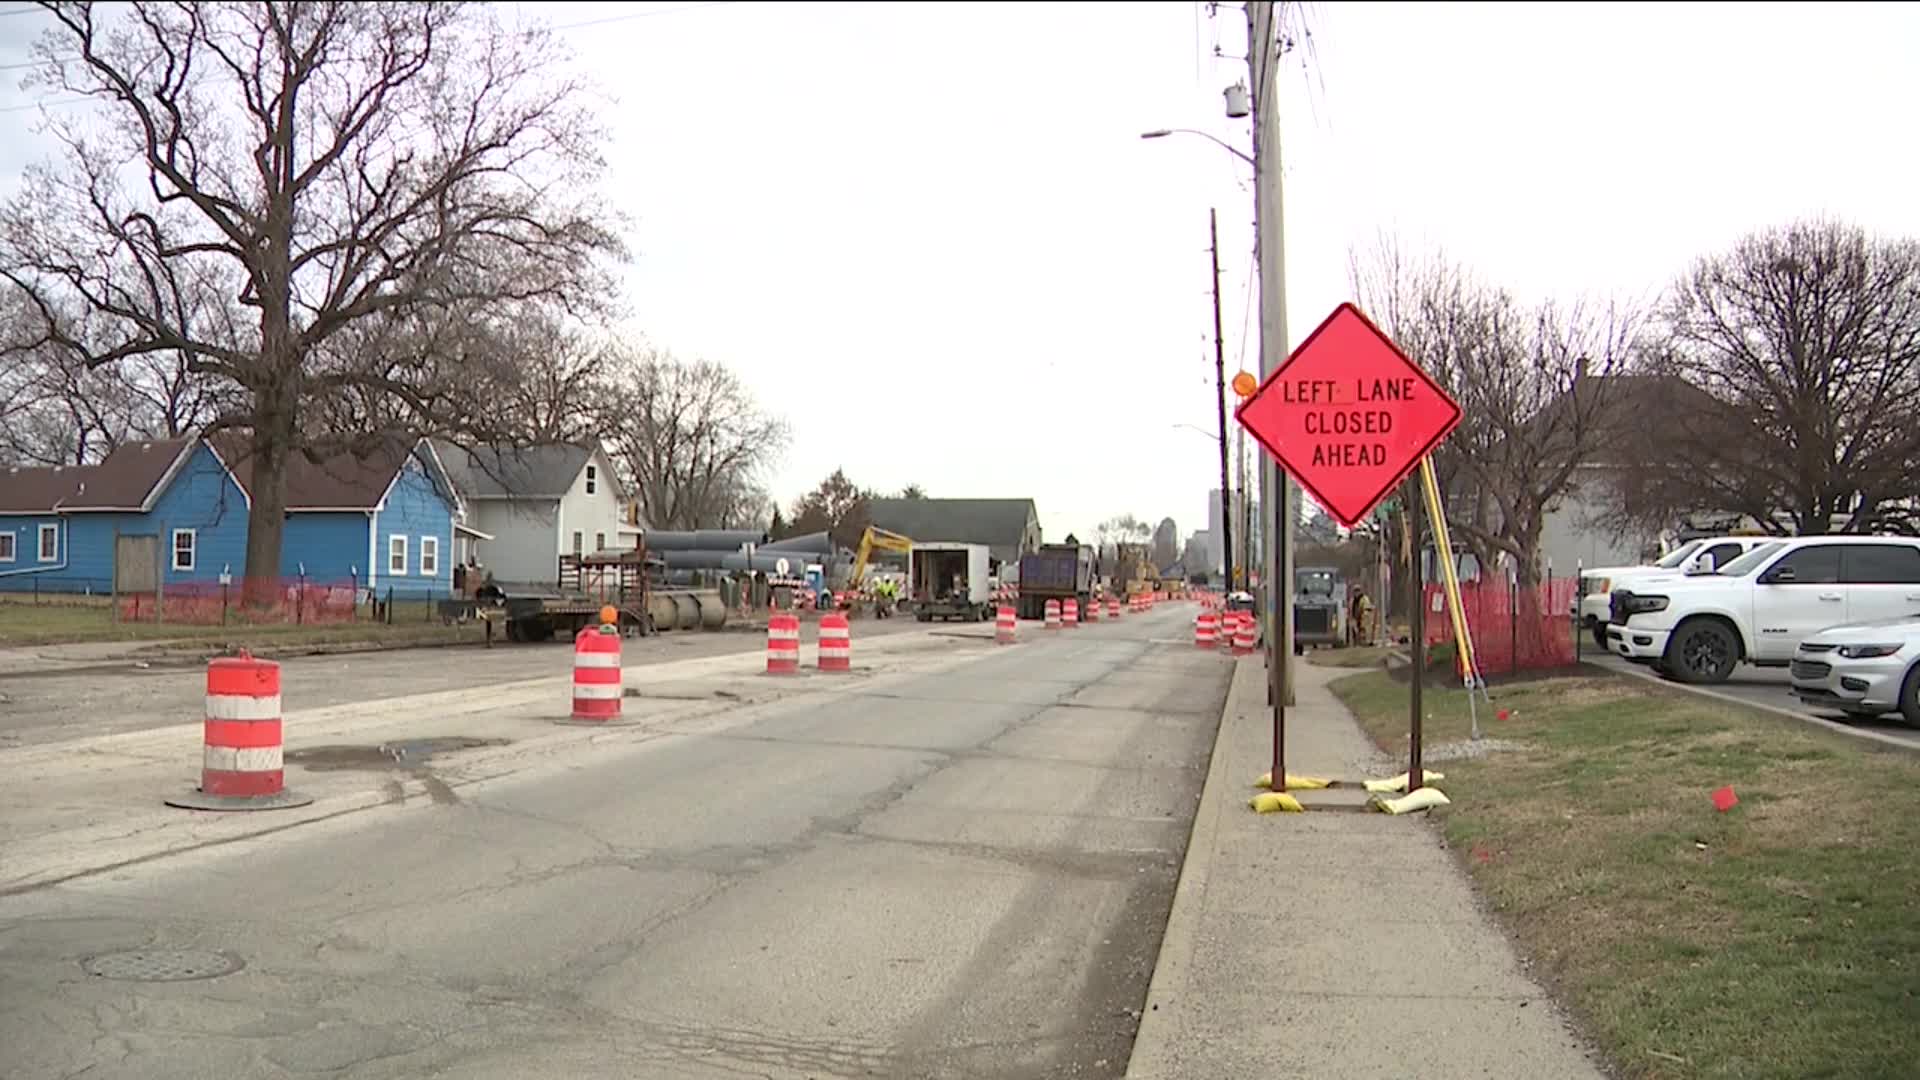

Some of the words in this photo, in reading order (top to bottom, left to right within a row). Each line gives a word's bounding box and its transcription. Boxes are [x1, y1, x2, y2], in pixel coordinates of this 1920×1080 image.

[1283, 381, 1336, 403] LEFT
[1357, 378, 1416, 402] LANE
[1304, 411, 1393, 434] CLOSED
[1311, 444, 1387, 467] AHEAD
